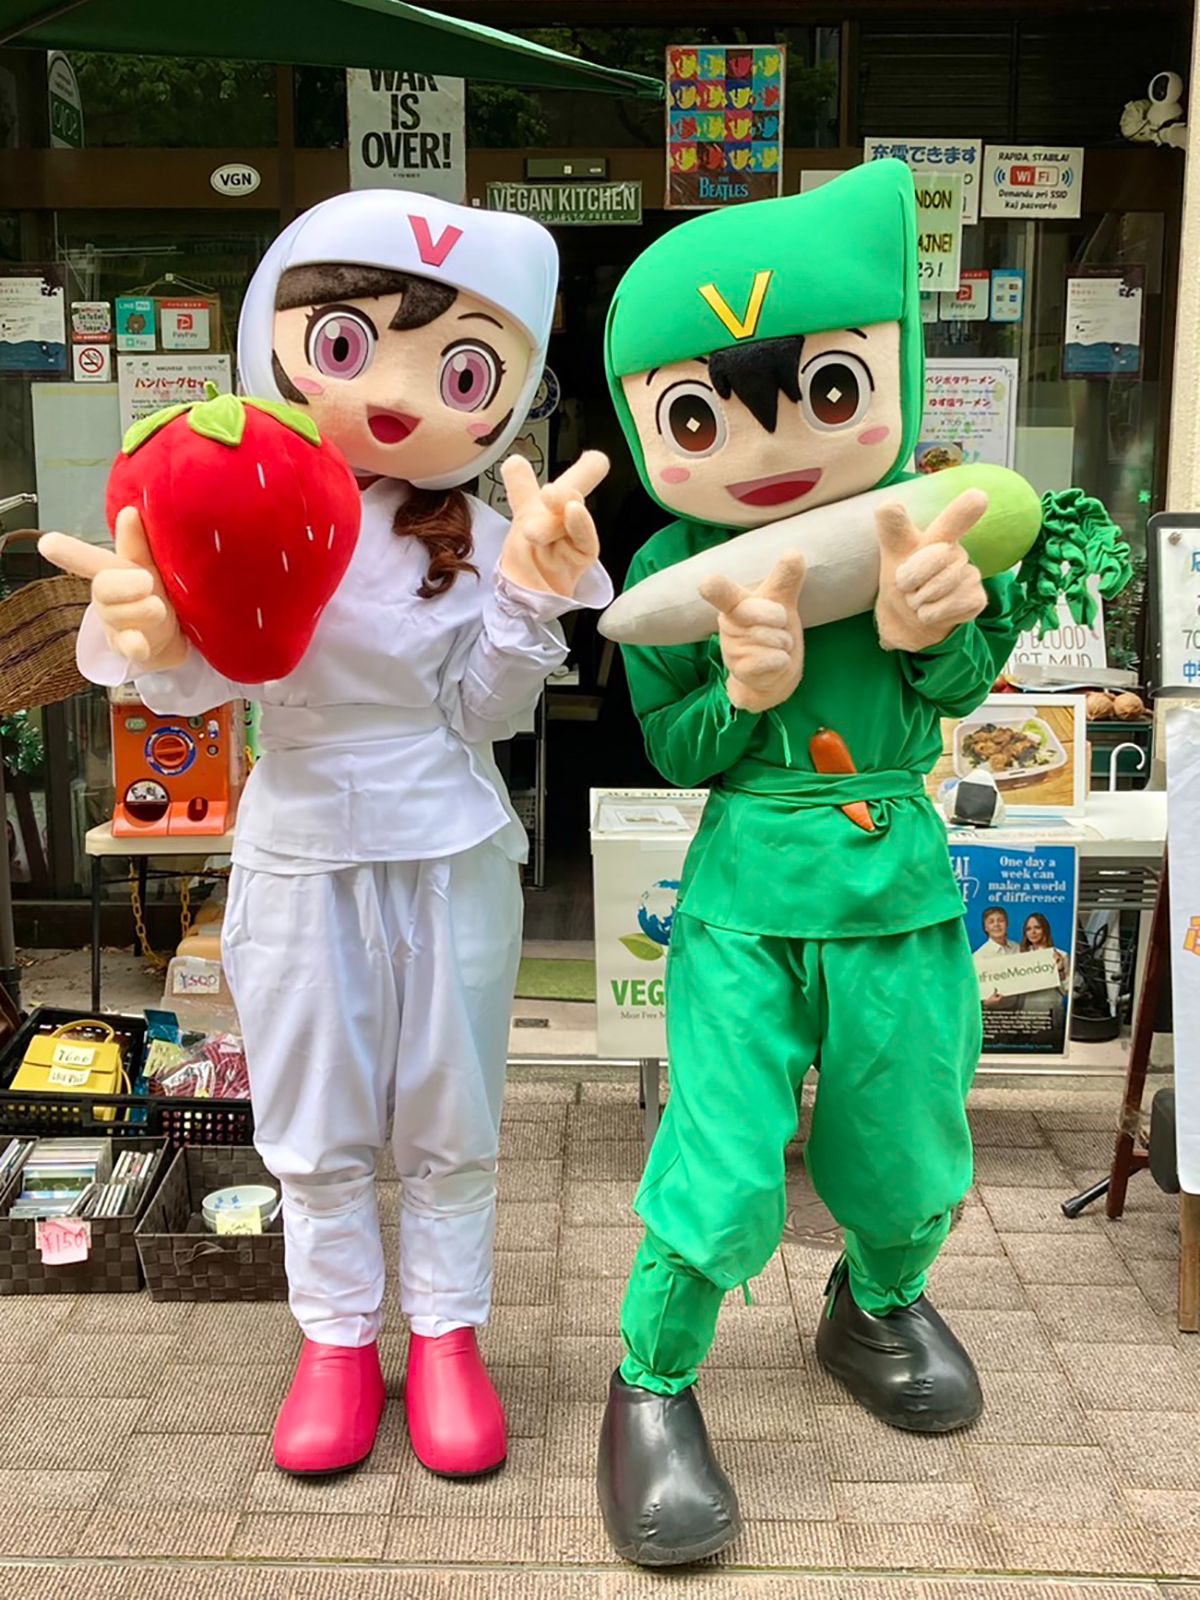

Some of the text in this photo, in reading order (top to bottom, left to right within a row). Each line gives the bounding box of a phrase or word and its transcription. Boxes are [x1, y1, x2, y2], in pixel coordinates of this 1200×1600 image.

[390, 93, 421, 130] IS
[362, 132, 452, 169] OVER!
[220, 173, 252, 186] VGN
[494, 188, 636, 211] VEGAN KITCHEN
[915, 189, 952, 208] NDON
[589, 212, 614, 221] FREE
[407, 214, 463, 267] V
[698, 270, 773, 341] V
[1000, 856, 1056, 870] One day a
[1001, 869, 1055, 879] week can
[988, 880, 1067, 891] make a world
[988, 892, 1065, 903] of difference
[979, 961, 1057, 982] FreeMonday
[611, 979, 665, 1006] VEG
